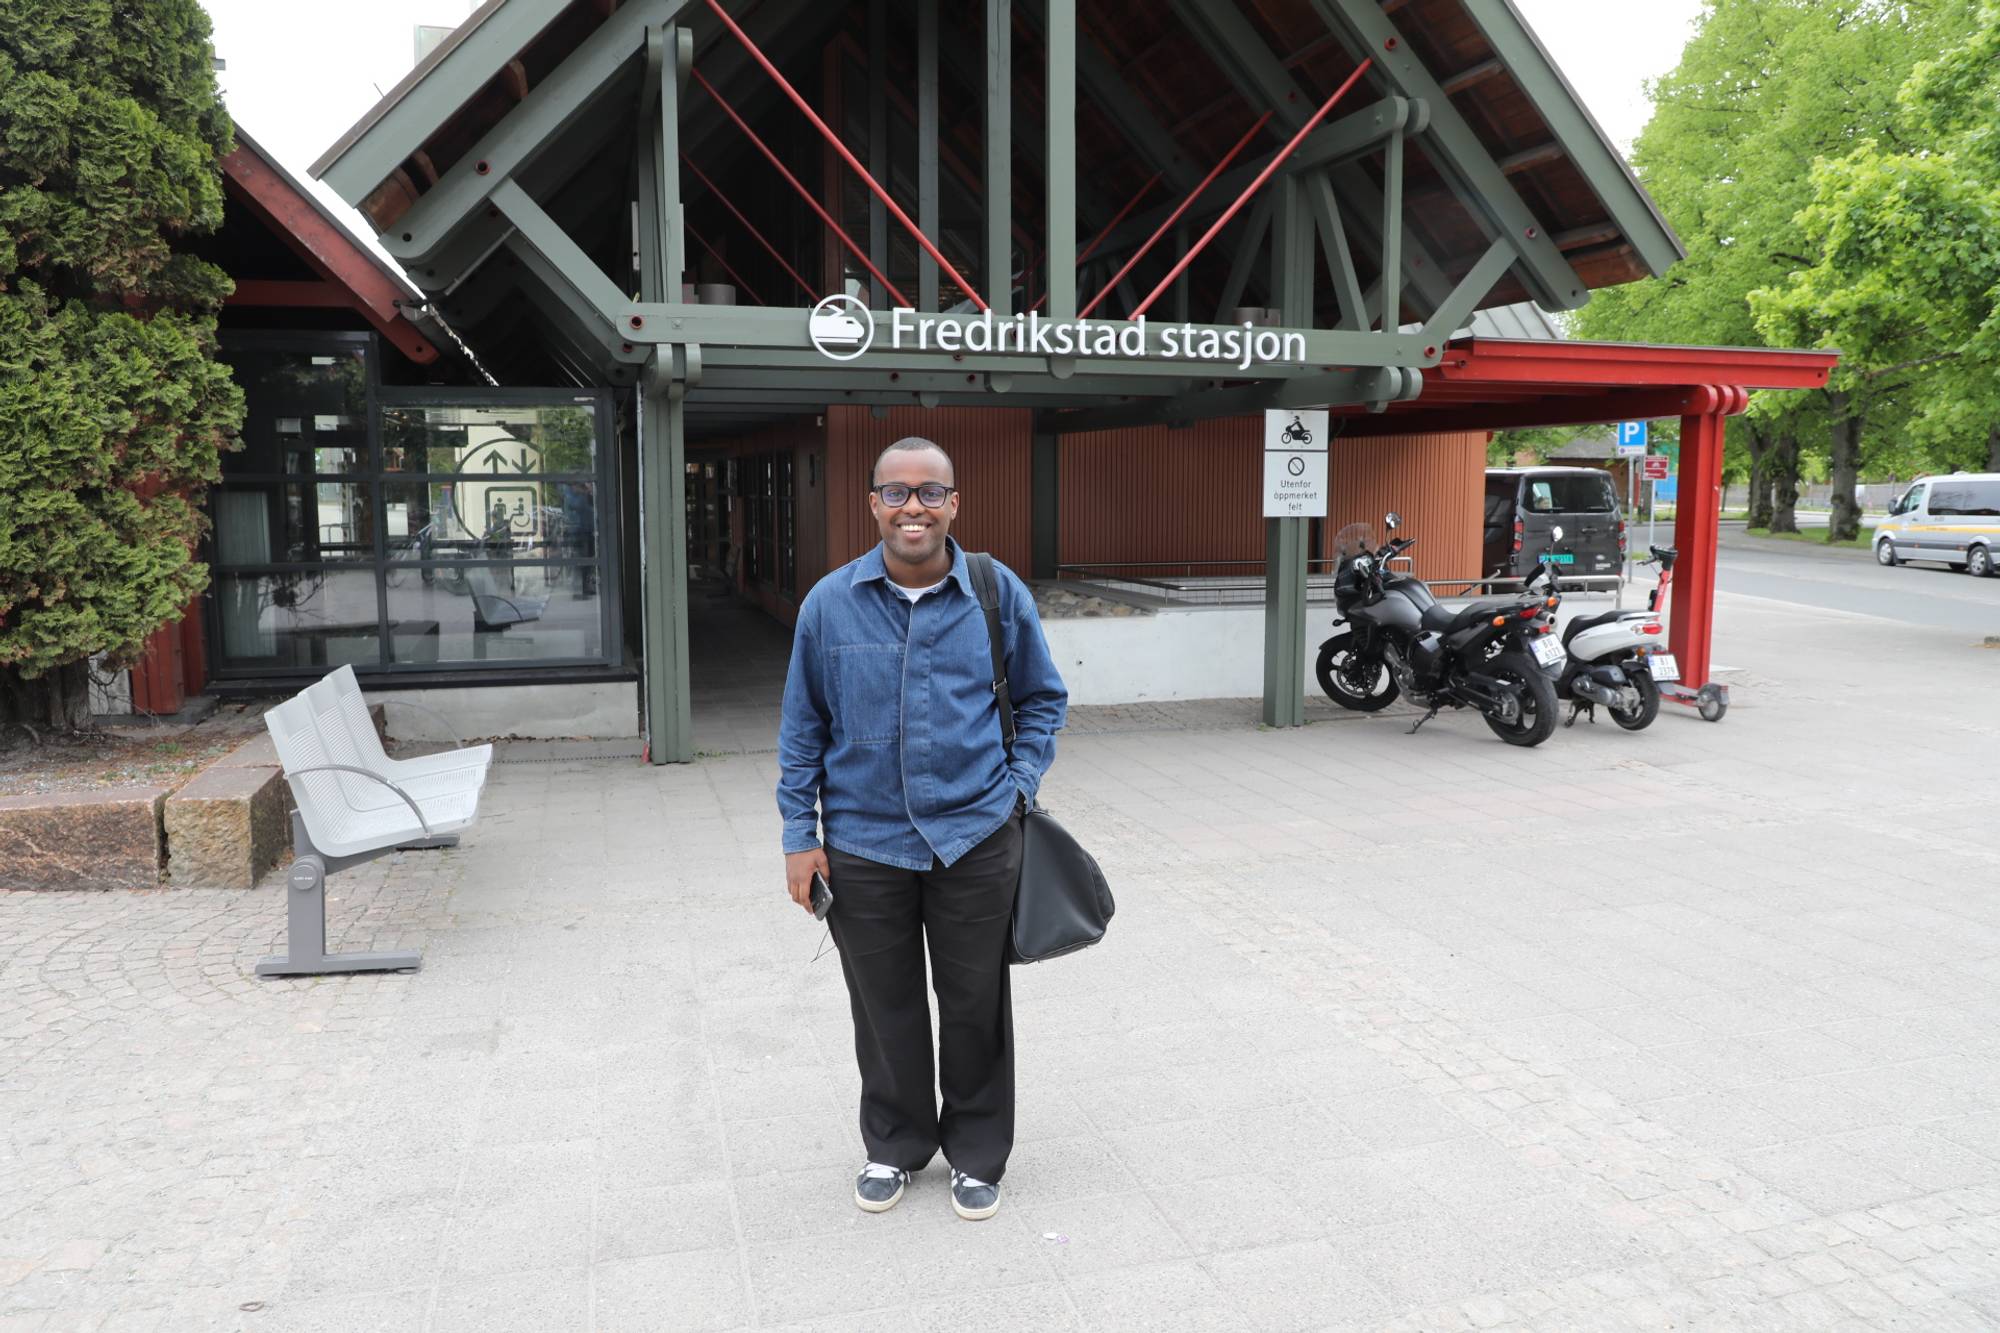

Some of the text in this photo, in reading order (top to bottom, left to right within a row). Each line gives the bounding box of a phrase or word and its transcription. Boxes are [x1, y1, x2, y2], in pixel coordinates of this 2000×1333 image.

[892, 307, 1306, 371] Fredrikstad stasjon
[1625, 421, 1640, 443] P
[1280, 480, 1311, 488] Utenfor
[1288, 502, 1302, 511] felt
